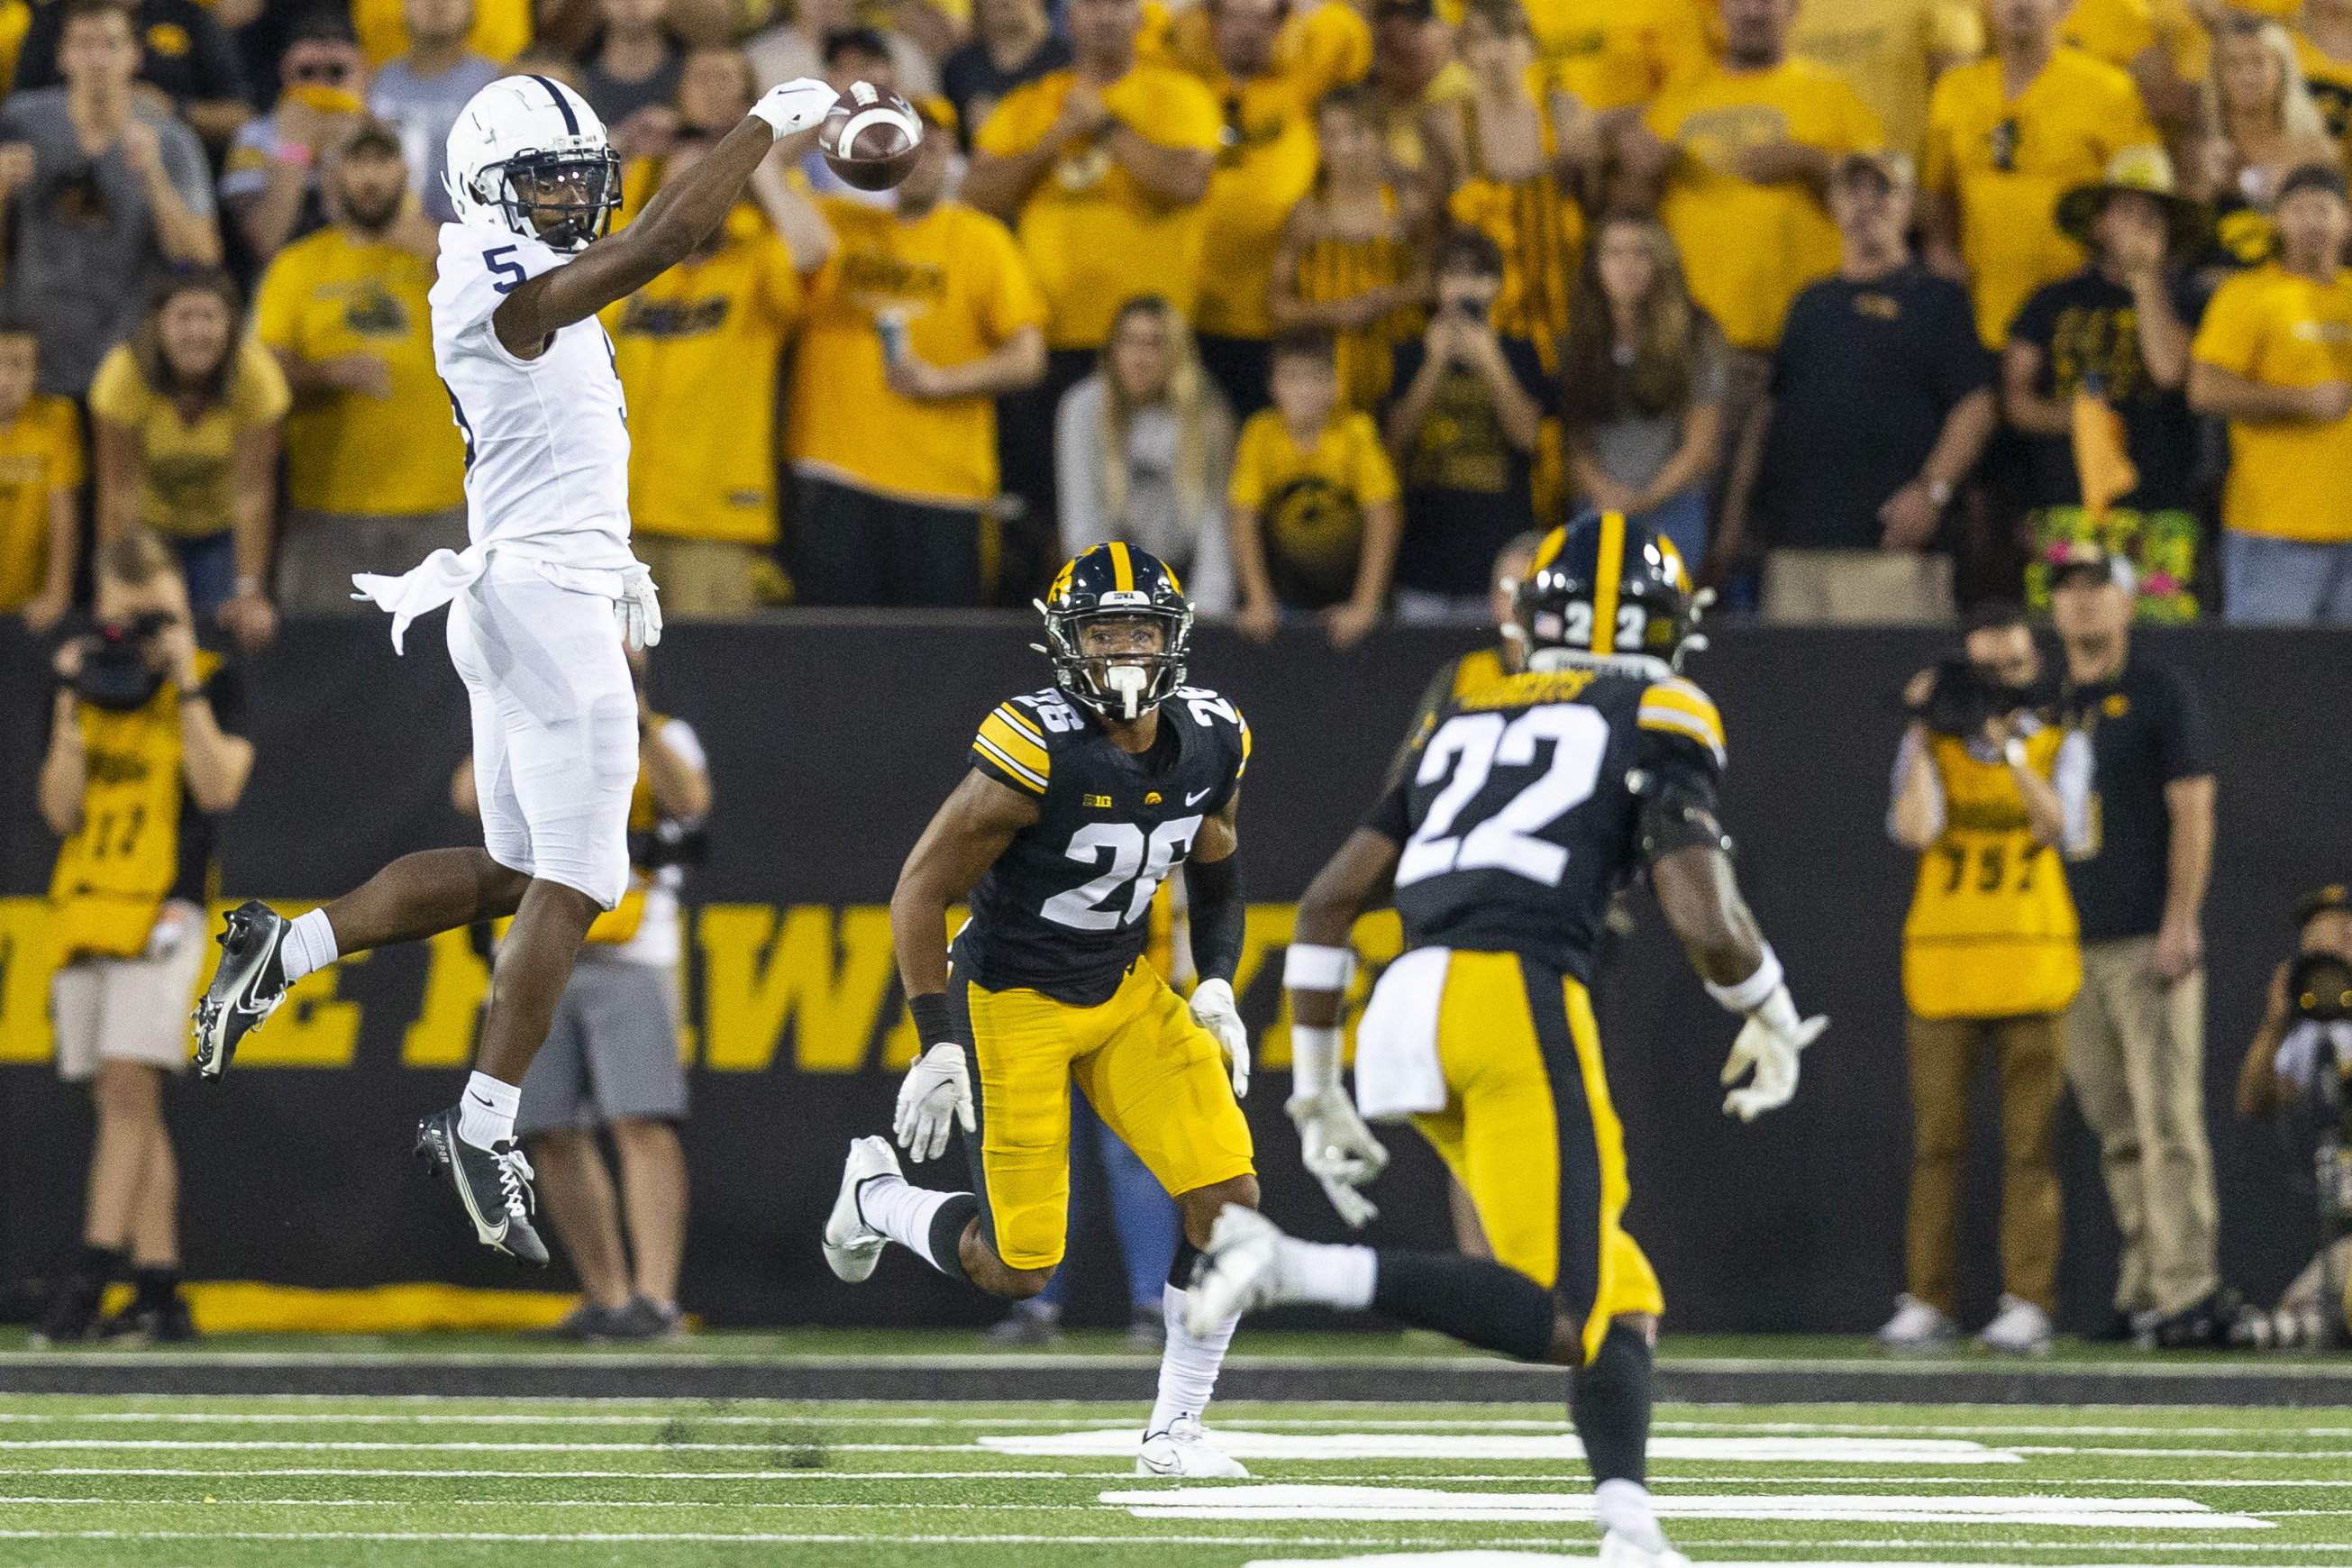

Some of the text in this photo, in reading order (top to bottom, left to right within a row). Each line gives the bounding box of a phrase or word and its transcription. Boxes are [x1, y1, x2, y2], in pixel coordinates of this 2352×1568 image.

[482, 242, 529, 295] 5
[1113, 592, 1135, 600] IOWA
[1011, 687, 1085, 733] 26
[1395, 702, 1611, 888] 22
[1040, 814, 1204, 930] 26
